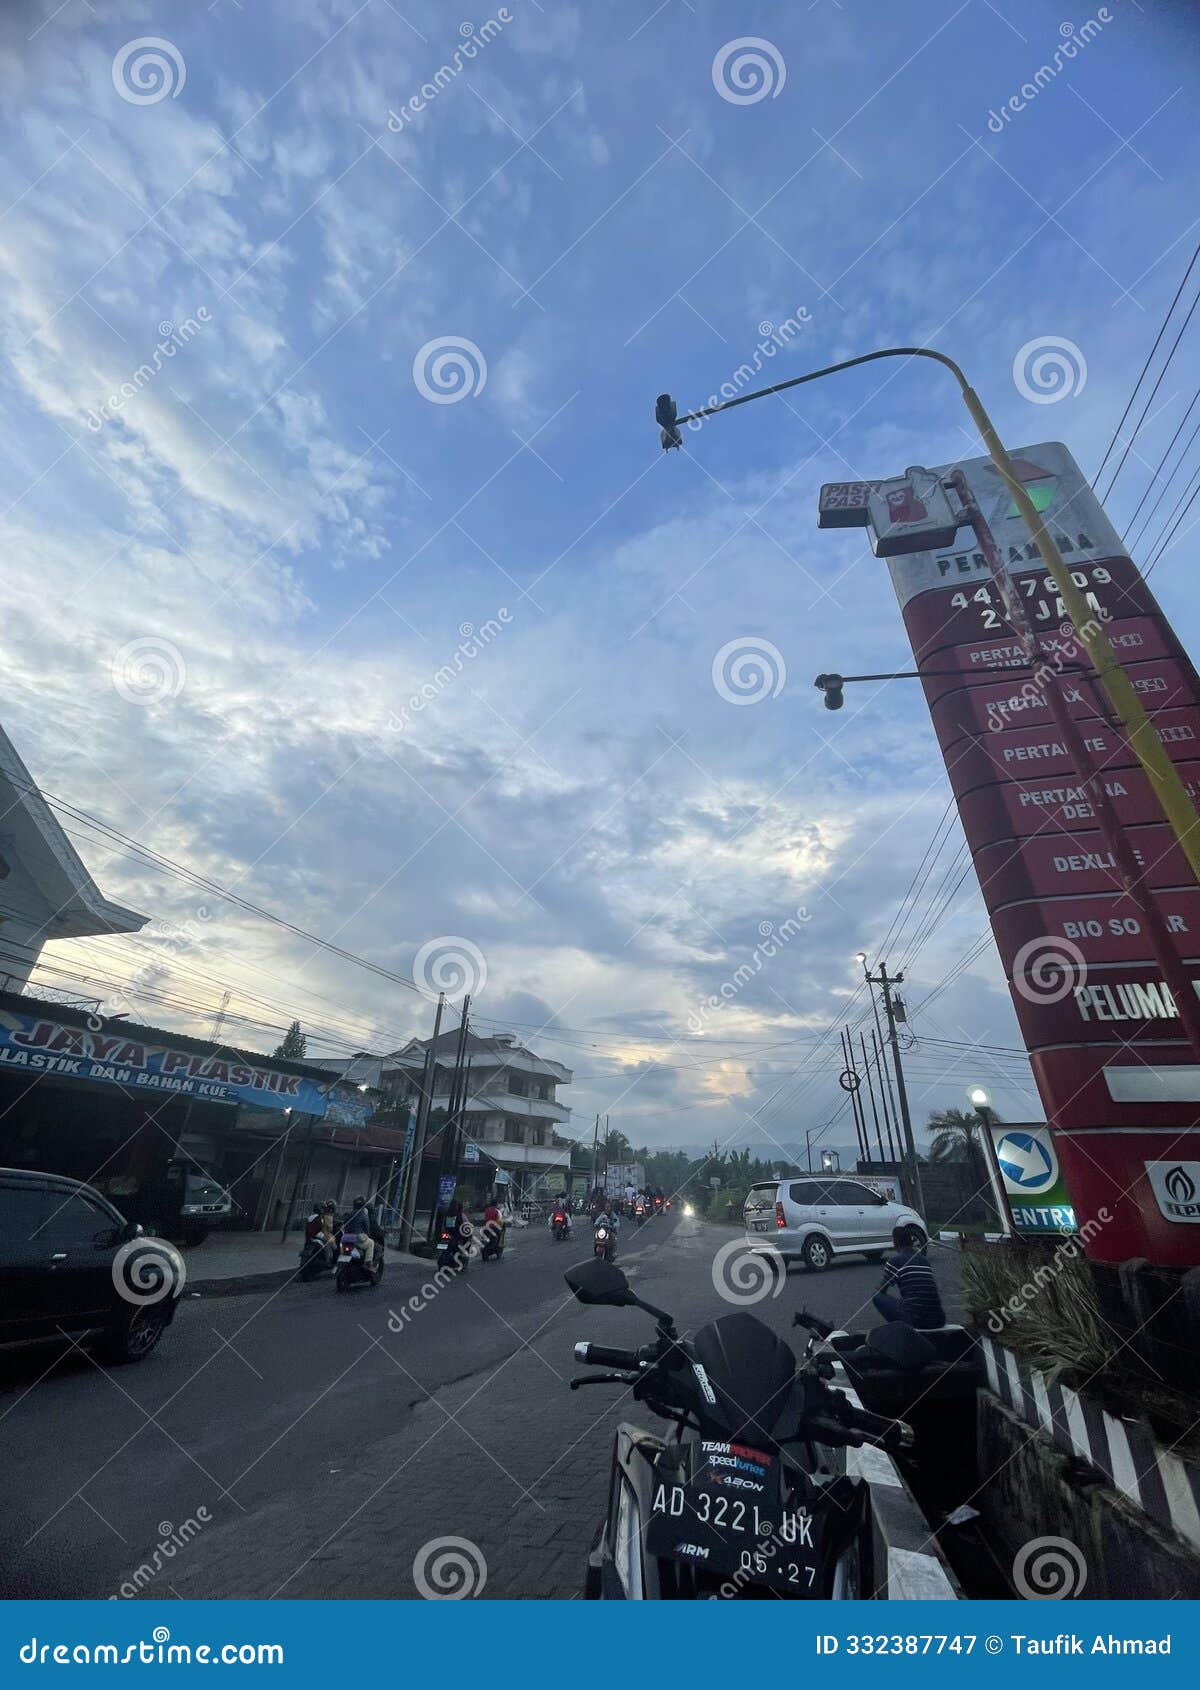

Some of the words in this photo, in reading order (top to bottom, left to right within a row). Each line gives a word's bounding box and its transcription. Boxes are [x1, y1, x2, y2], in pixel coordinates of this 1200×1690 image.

[936, 533, 1094, 577] PERAMNA
[970, 639, 1062, 662] PERTAAX
[985, 688, 1081, 713] PERTAX
[1003, 738, 1107, 762] PERTATE
[1018, 782, 1128, 807] PERTANA
[1053, 850, 1146, 873] DEXLIE
[1062, 920, 1103, 939] BIO
[1108, 915, 1189, 936] SOR
[1072, 980, 1200, 1022] PELUMA
[0, 1048, 82, 1075] LASTIK
[90, 1064, 131, 1083] DAN
[136, 1072, 194, 1092] BAHAN
[9, 1019, 148, 1069] JAYA
[161, 1051, 302, 1097] PLASTIK
[1011, 1207, 1077, 1226] ENTRY
[653, 1484, 685, 1516] AD
[697, 1493, 759, 1535] 3221
[782, 1511, 813, 1548] UK
